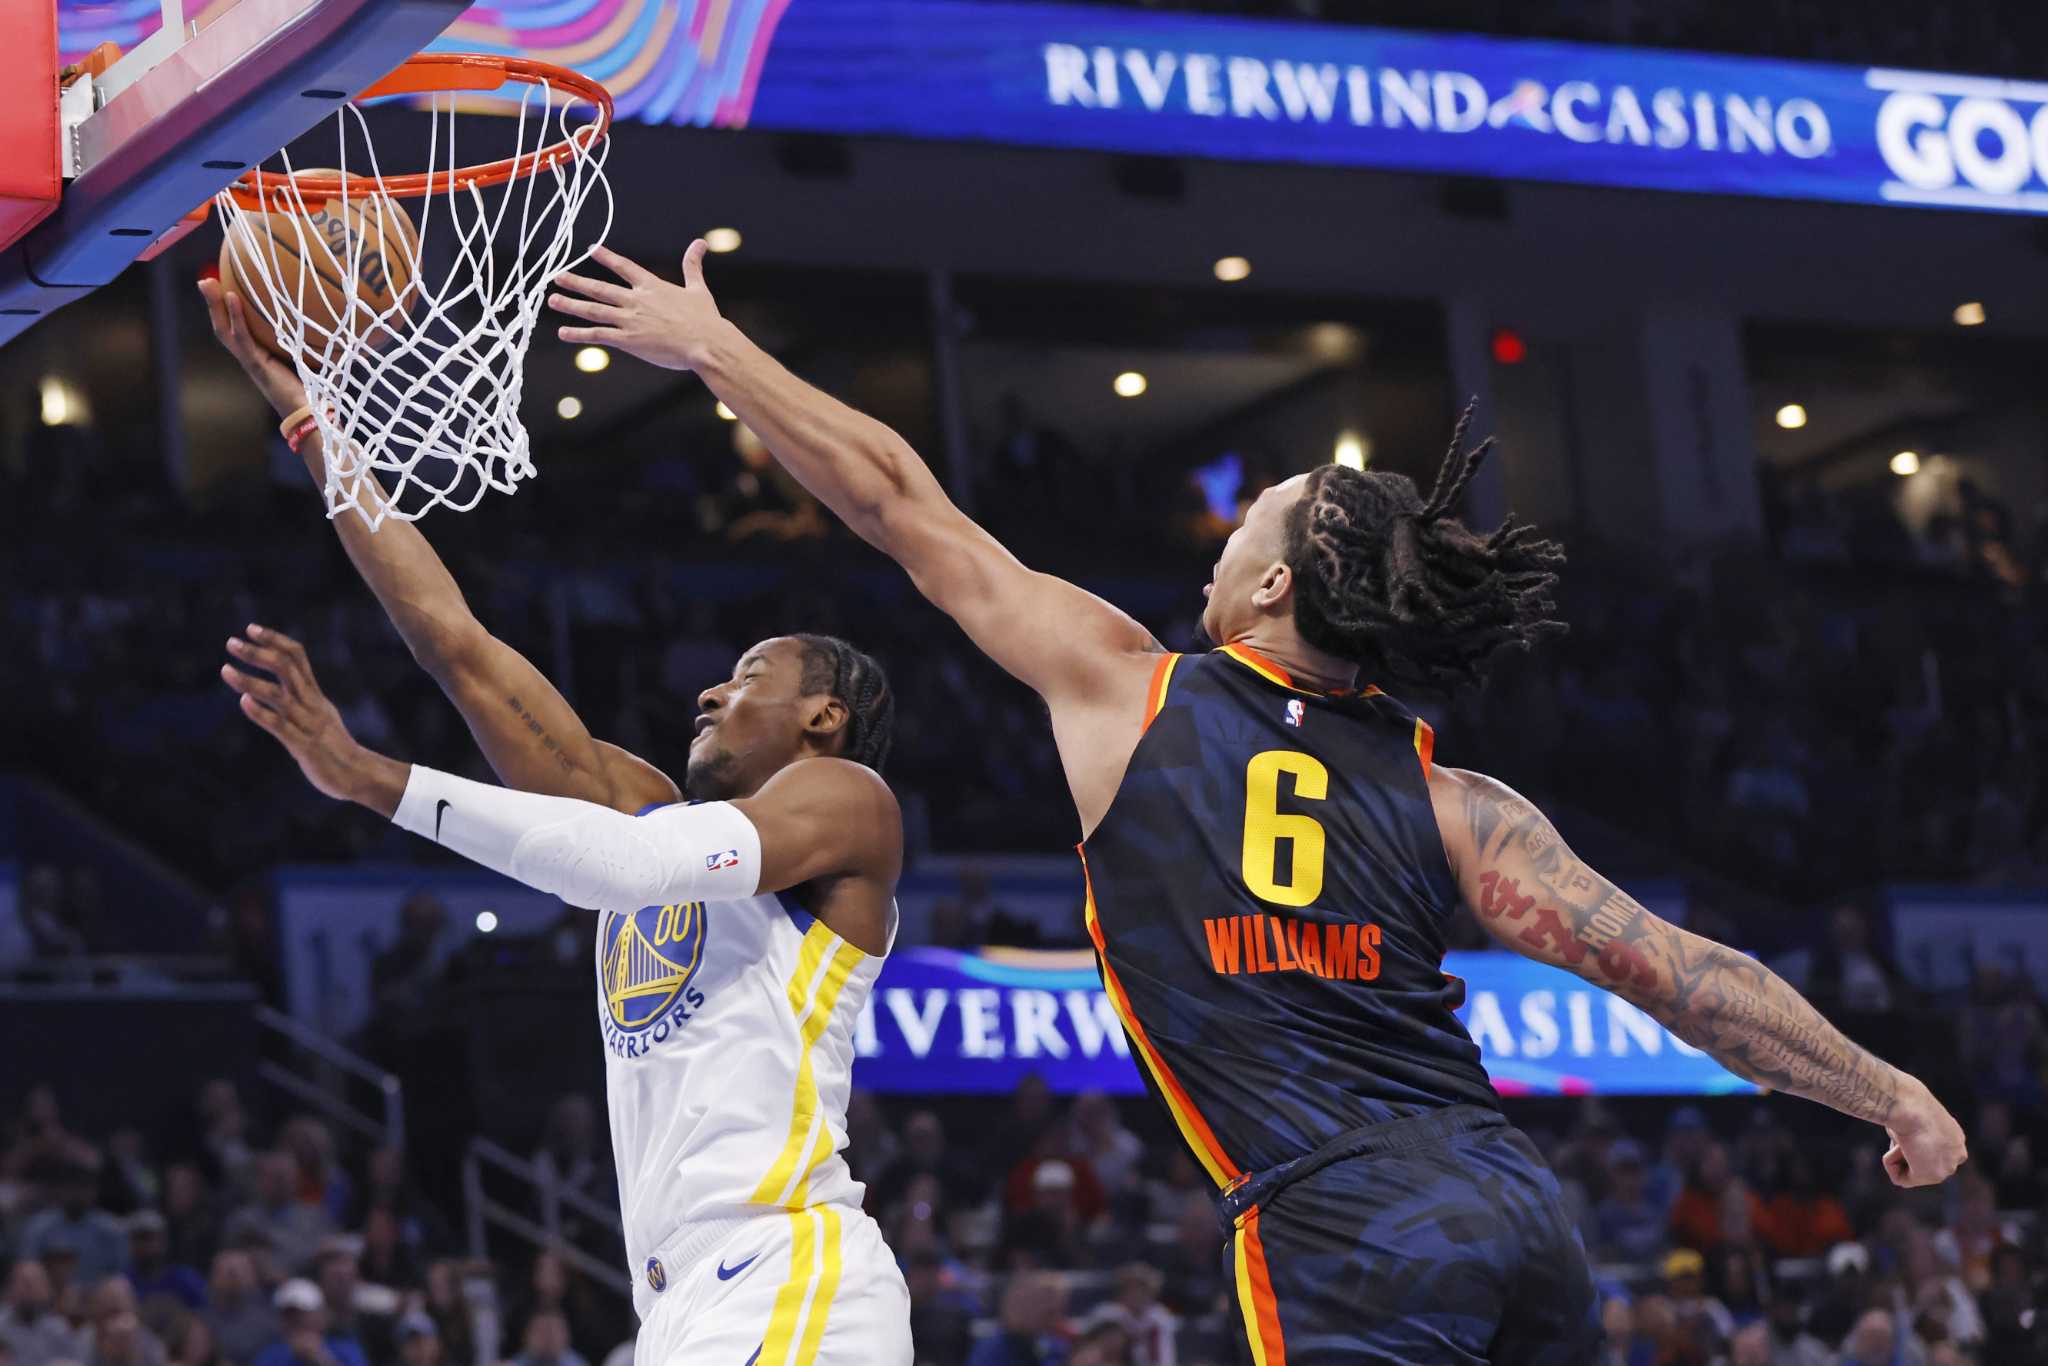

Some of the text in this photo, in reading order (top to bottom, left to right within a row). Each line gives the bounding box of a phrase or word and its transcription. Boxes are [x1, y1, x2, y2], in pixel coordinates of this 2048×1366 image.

[1045, 42, 1833, 160] RIVERWIND CASINO
[1875, 89, 2048, 196] GO
[1242, 750, 1329, 907] 6
[1203, 914, 1382, 981] WILLIAMS
[1469, 989, 1706, 1059] ASIN
